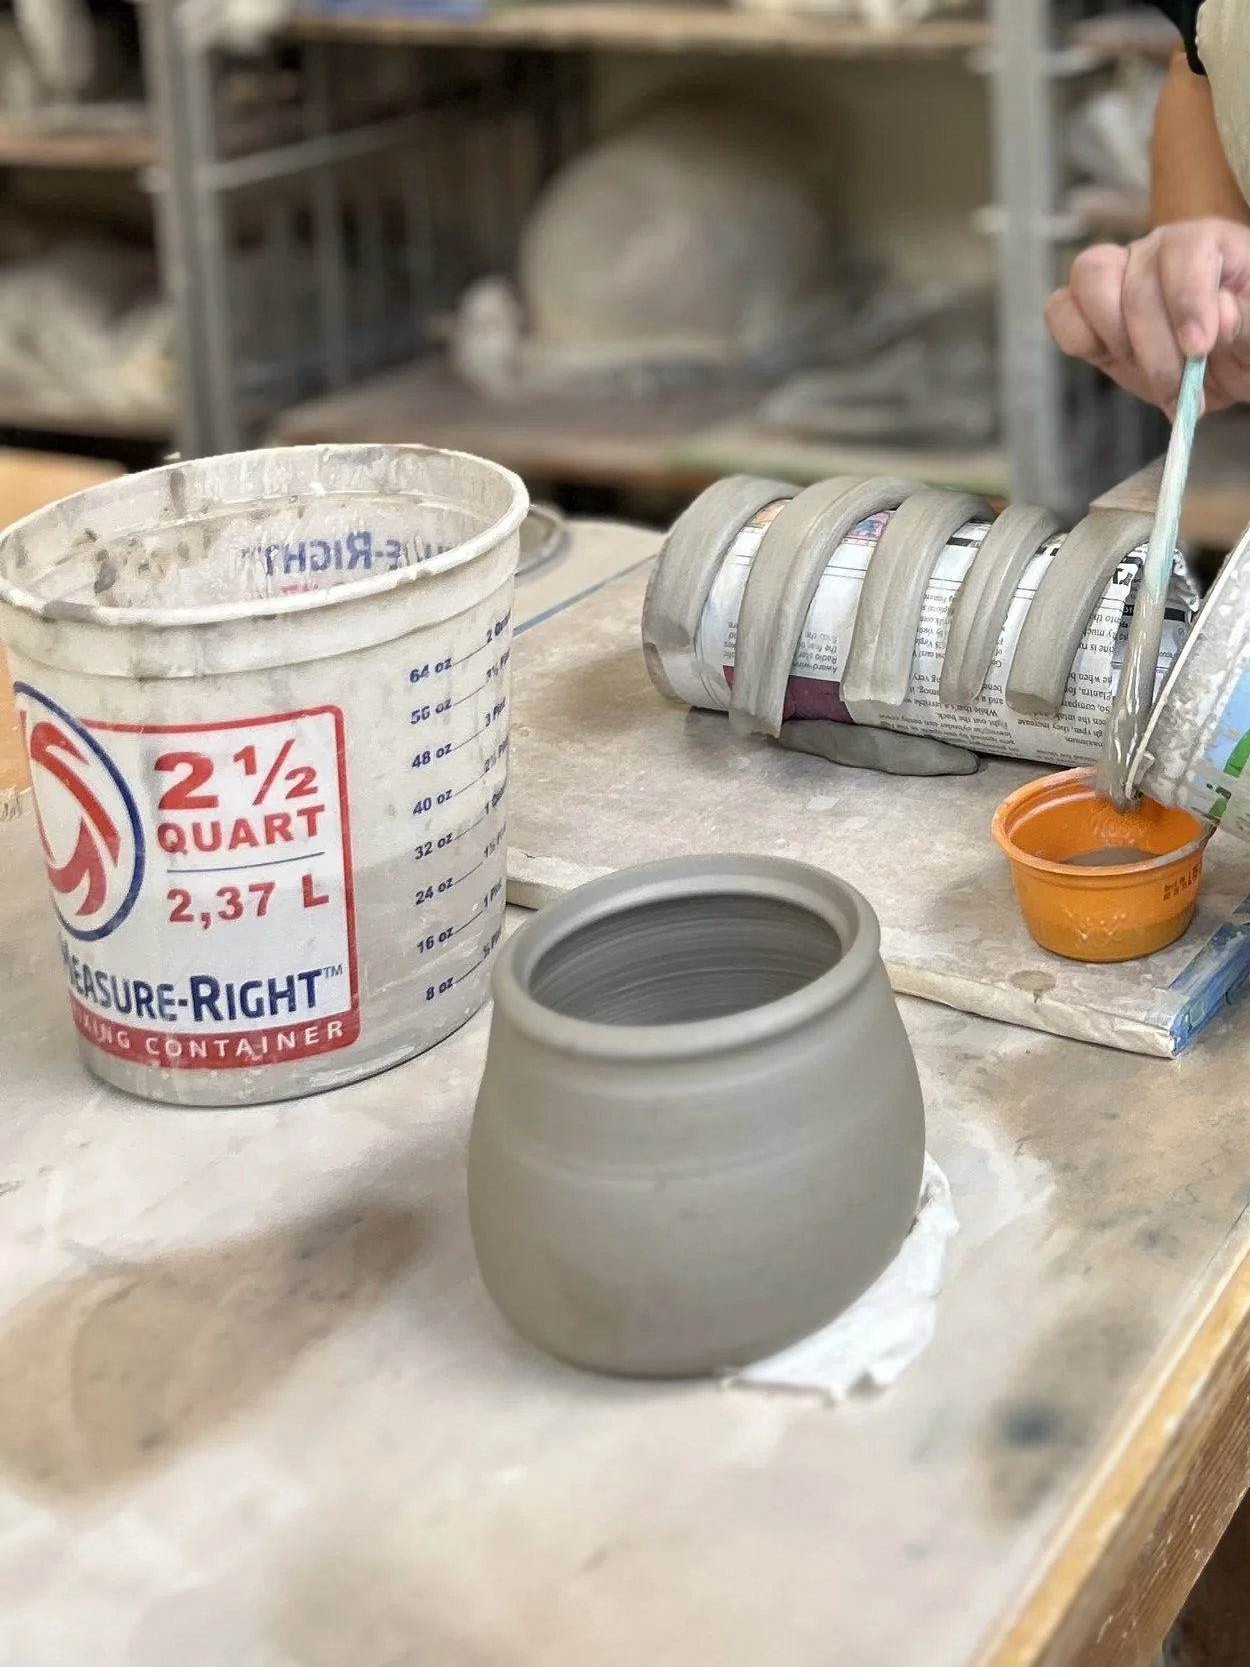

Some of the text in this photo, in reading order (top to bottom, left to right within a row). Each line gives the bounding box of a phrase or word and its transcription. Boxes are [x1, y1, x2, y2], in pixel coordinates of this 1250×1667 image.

[409, 657, 452, 683] 64 oz
[410, 697, 452, 725] 56 oz
[411, 743, 453, 768] 48 oz
[154, 751, 219, 810] 2
[412, 789, 453, 814] 40 oz
[157, 804, 326, 855] QUART
[414, 832, 453, 860] 32 oz
[167, 874, 330, 930] 2,37 L
[415, 877, 453, 905] 24 oz
[417, 926, 454, 954] 16 oz
[425, 977, 454, 1001] 8 oz
[146, 1020, 343, 1059] CONTAINER
